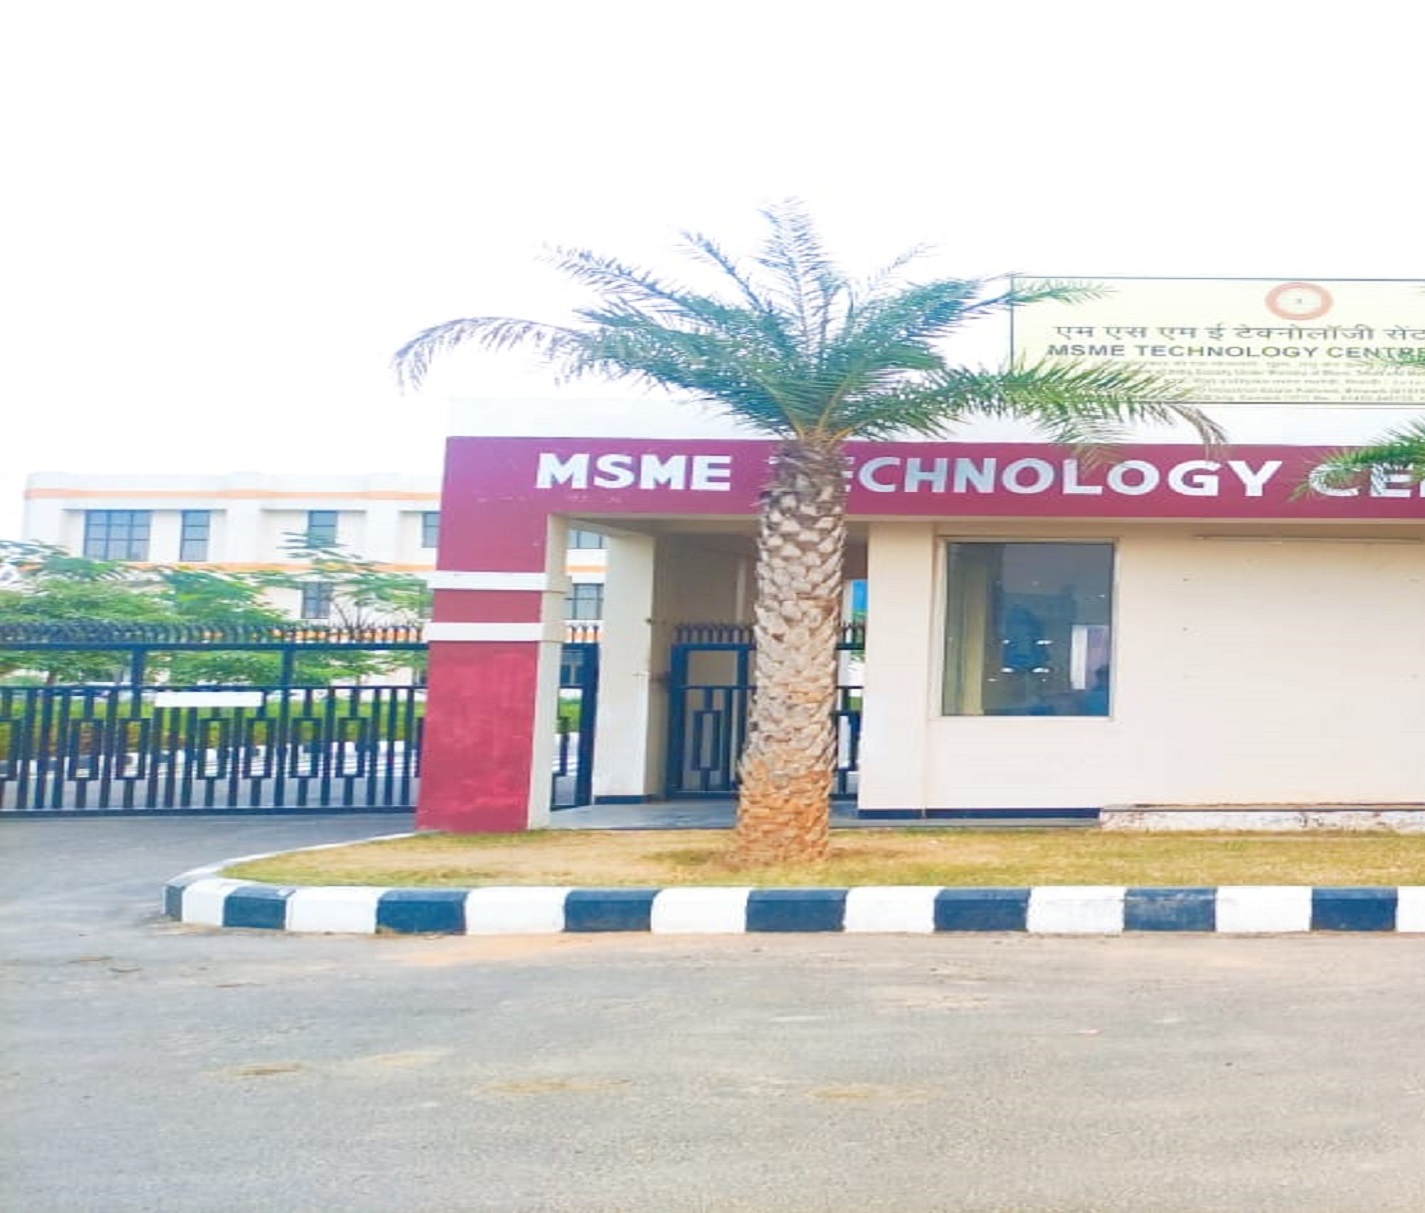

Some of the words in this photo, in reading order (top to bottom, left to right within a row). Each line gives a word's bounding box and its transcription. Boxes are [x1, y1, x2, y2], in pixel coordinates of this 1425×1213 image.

[1055, 325, 1094, 340] एम
[1103, 325, 1146, 341] एस
[1157, 325, 1196, 341] एम
[1204, 322, 1225, 341] ई
[1048, 344, 1125, 357] MSME
[1136, 345, 1316, 358] TECHNOLOGY
[535, 453, 731, 491] MSME
[768, 456, 1283, 497] CHNOLOGY
